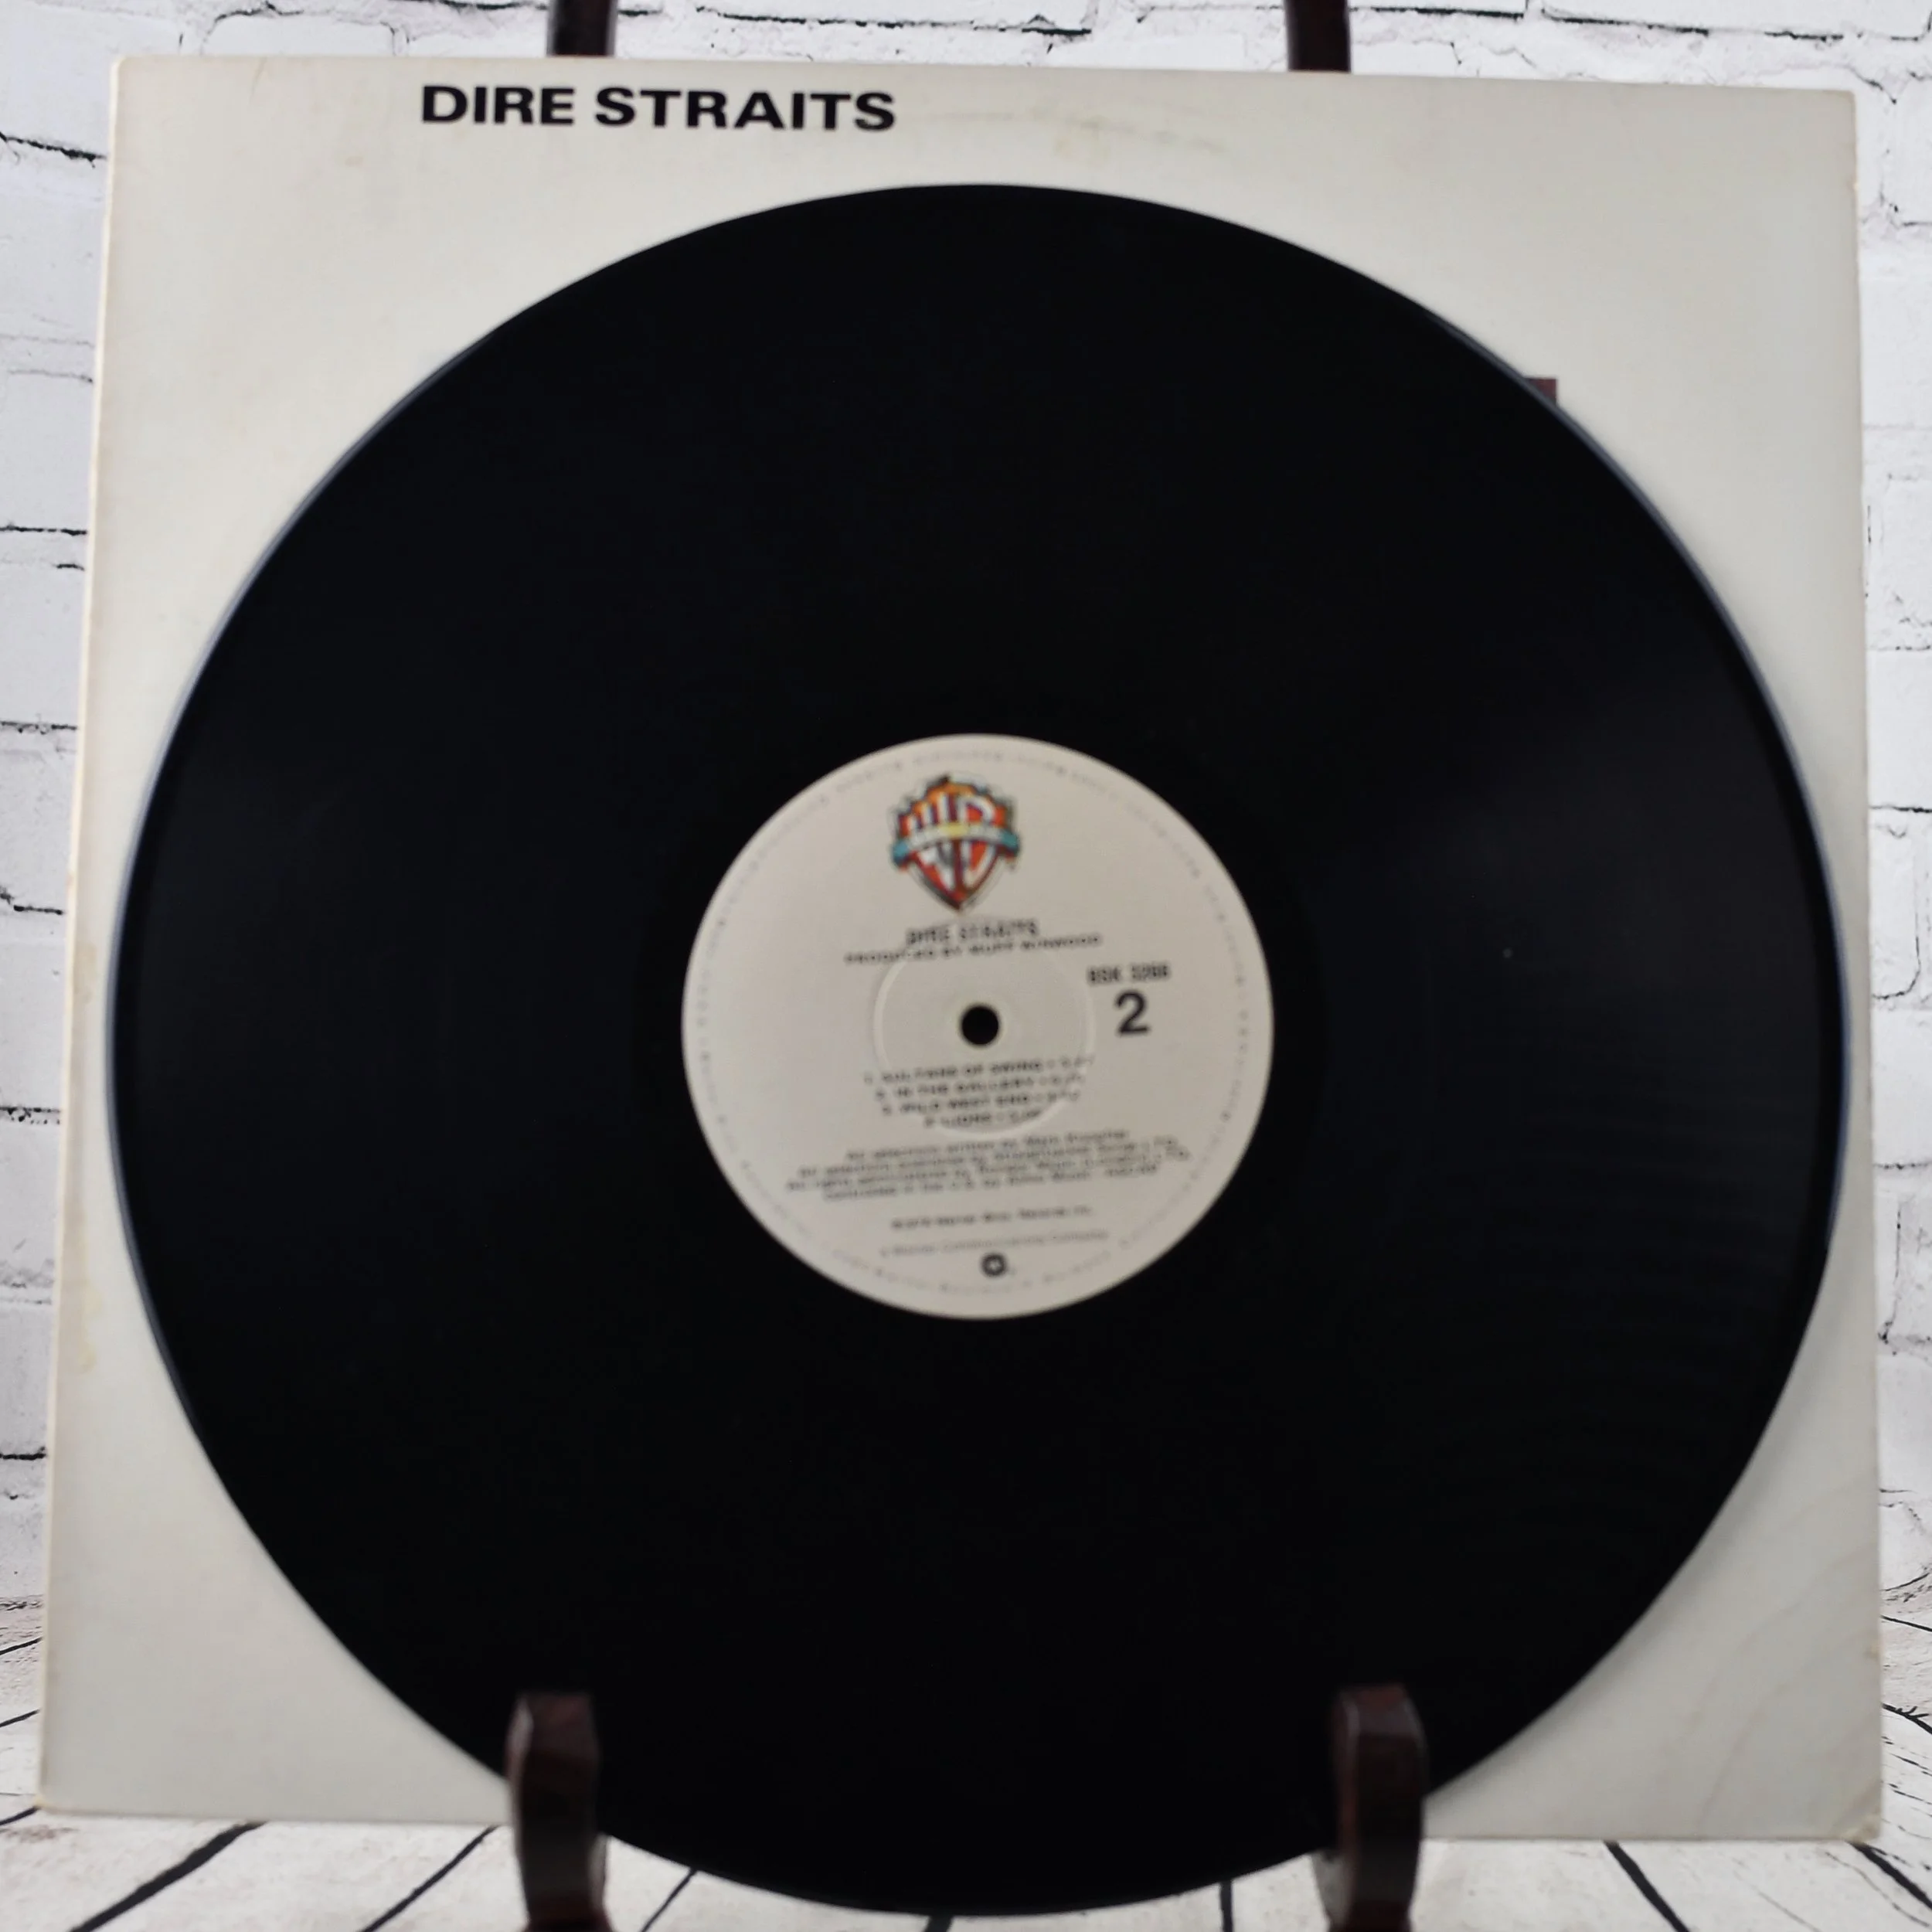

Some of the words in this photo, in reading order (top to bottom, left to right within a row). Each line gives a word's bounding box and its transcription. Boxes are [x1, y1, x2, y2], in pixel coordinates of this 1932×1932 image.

[421, 85, 575, 126] DIRE
[594, 87, 896, 131] STRAITS
[1114, 991, 1149, 1035] 2
